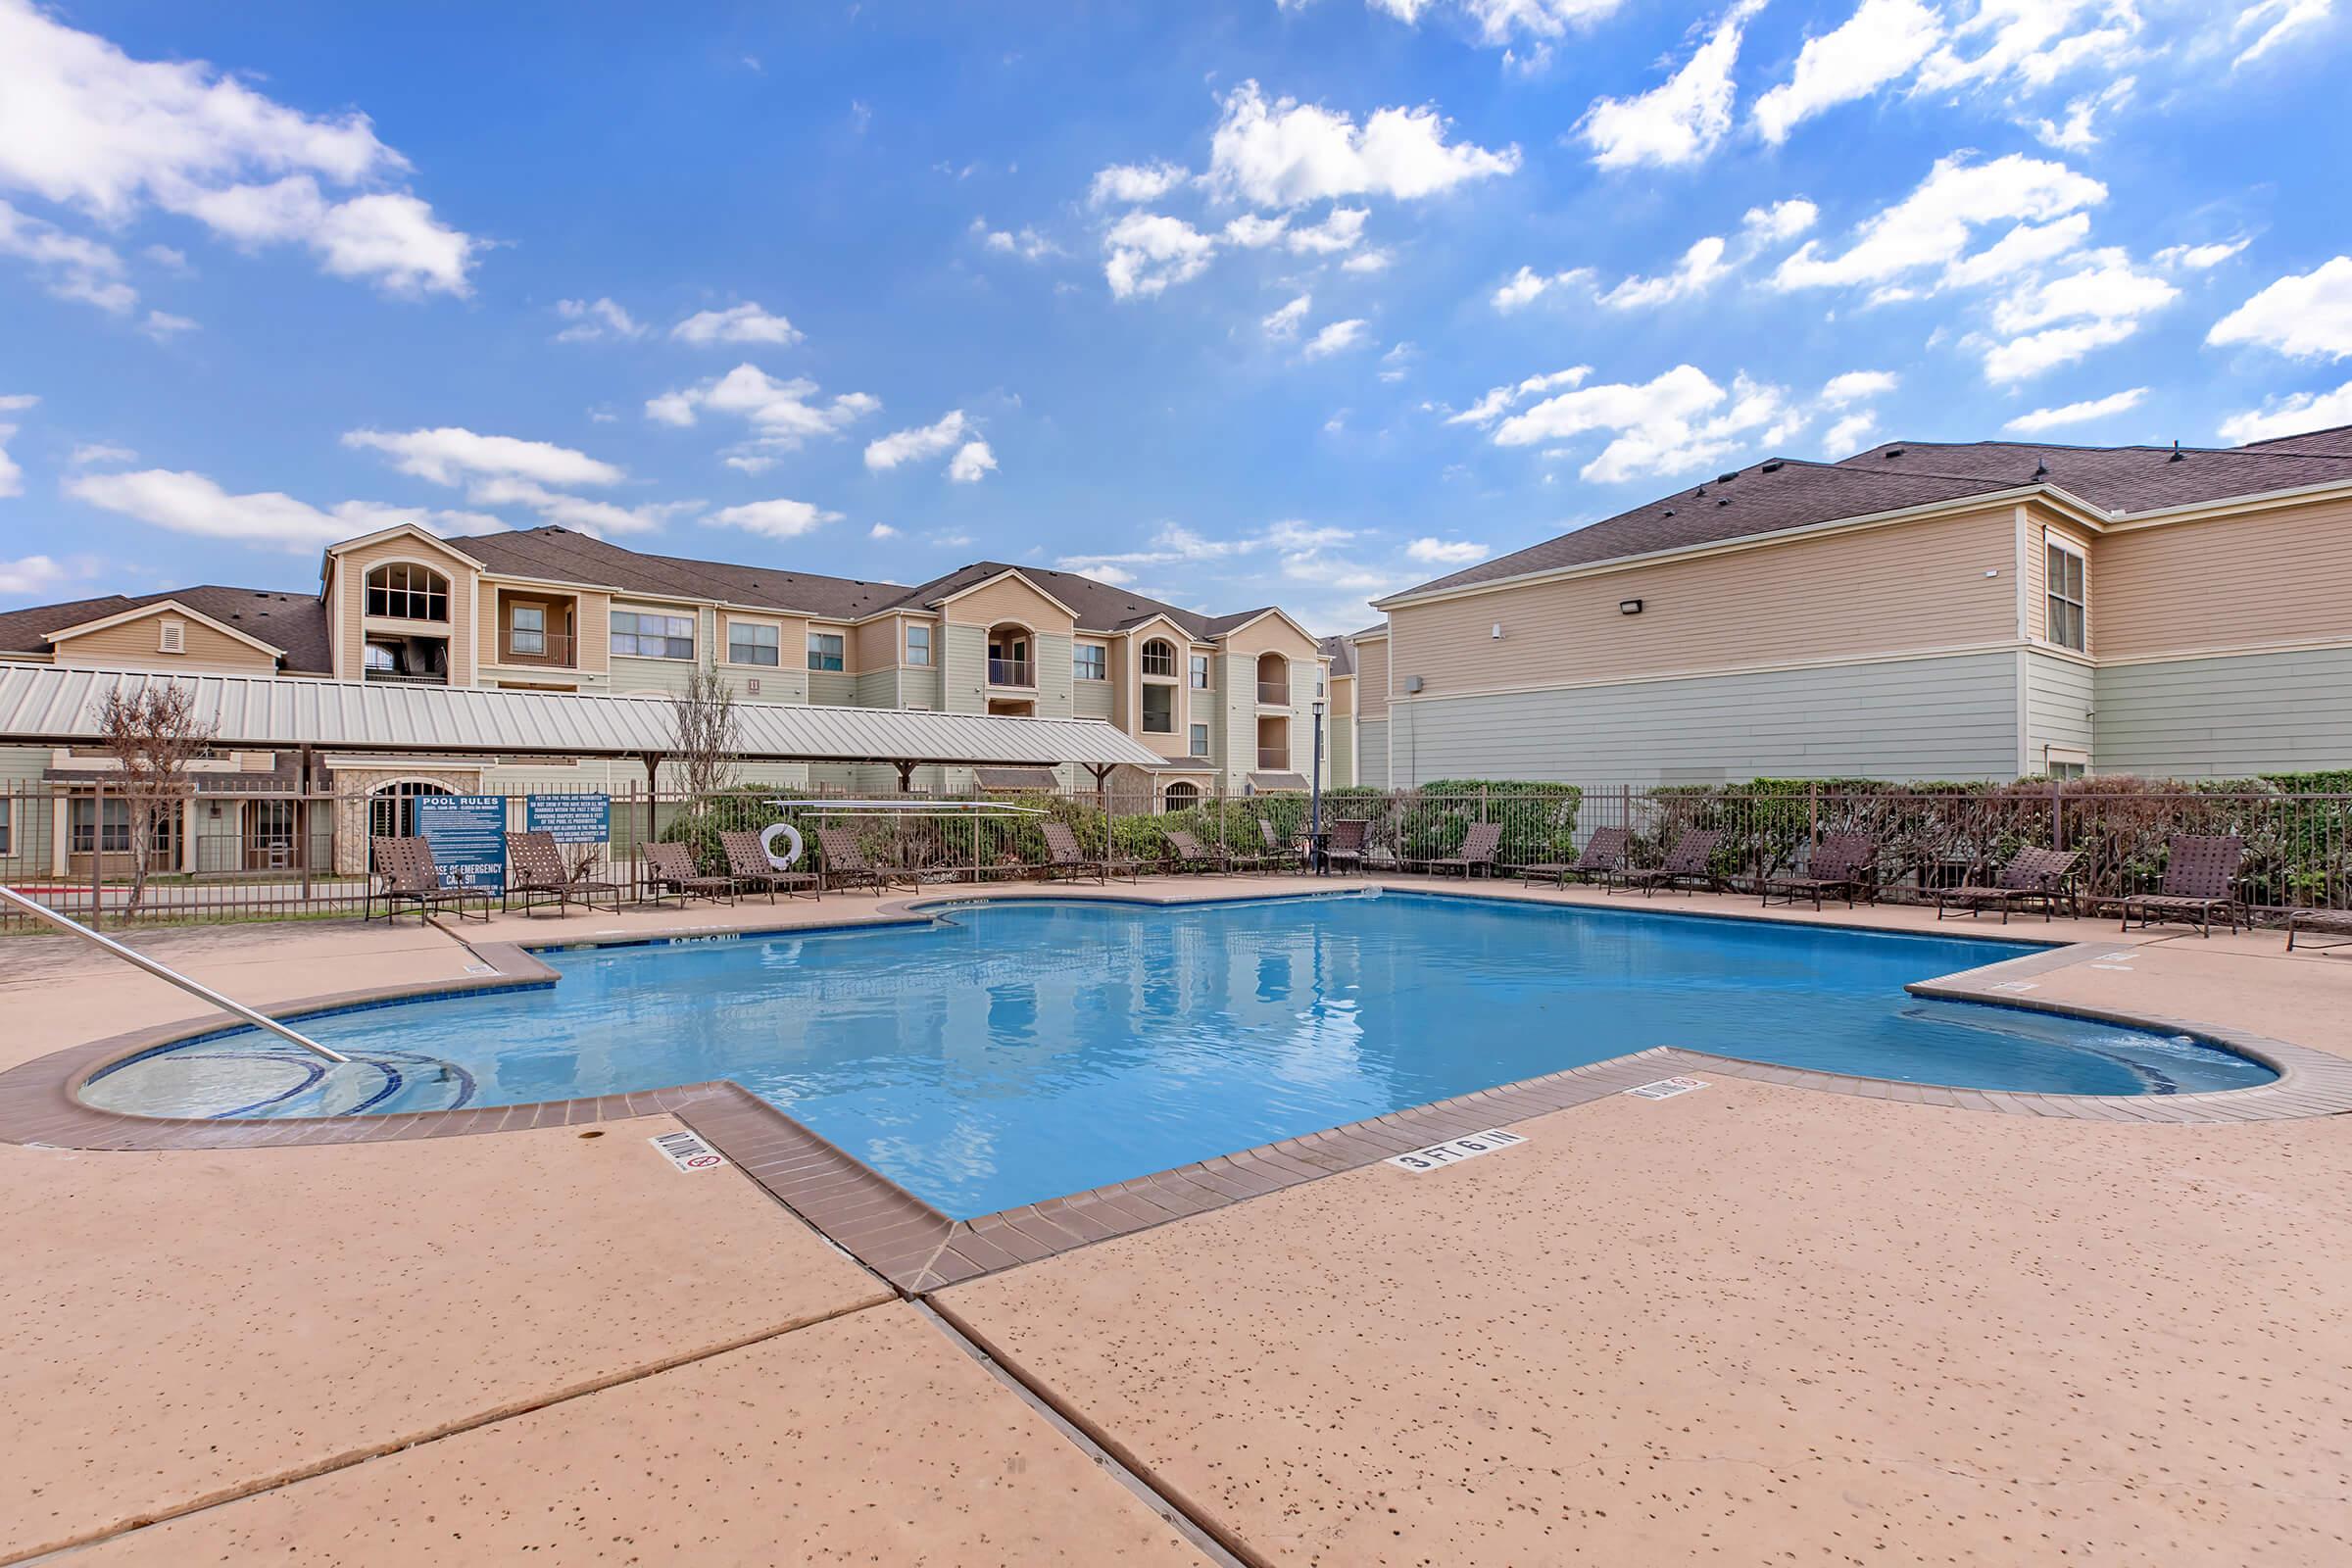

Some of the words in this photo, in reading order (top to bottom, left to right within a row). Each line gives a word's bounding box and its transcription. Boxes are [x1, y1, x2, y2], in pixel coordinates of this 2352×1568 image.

[435, 865, 447, 875] ASE
[450, 864, 459, 875] OF
[461, 863, 502, 874] EMERGENCY
[465, 875, 476, 884] 911
[1399, 1156, 1432, 1168] 3
[1422, 1147, 1463, 1162] FT
[1456, 1141, 1489, 1151] 6
[1478, 1131, 1521, 1145] IN
